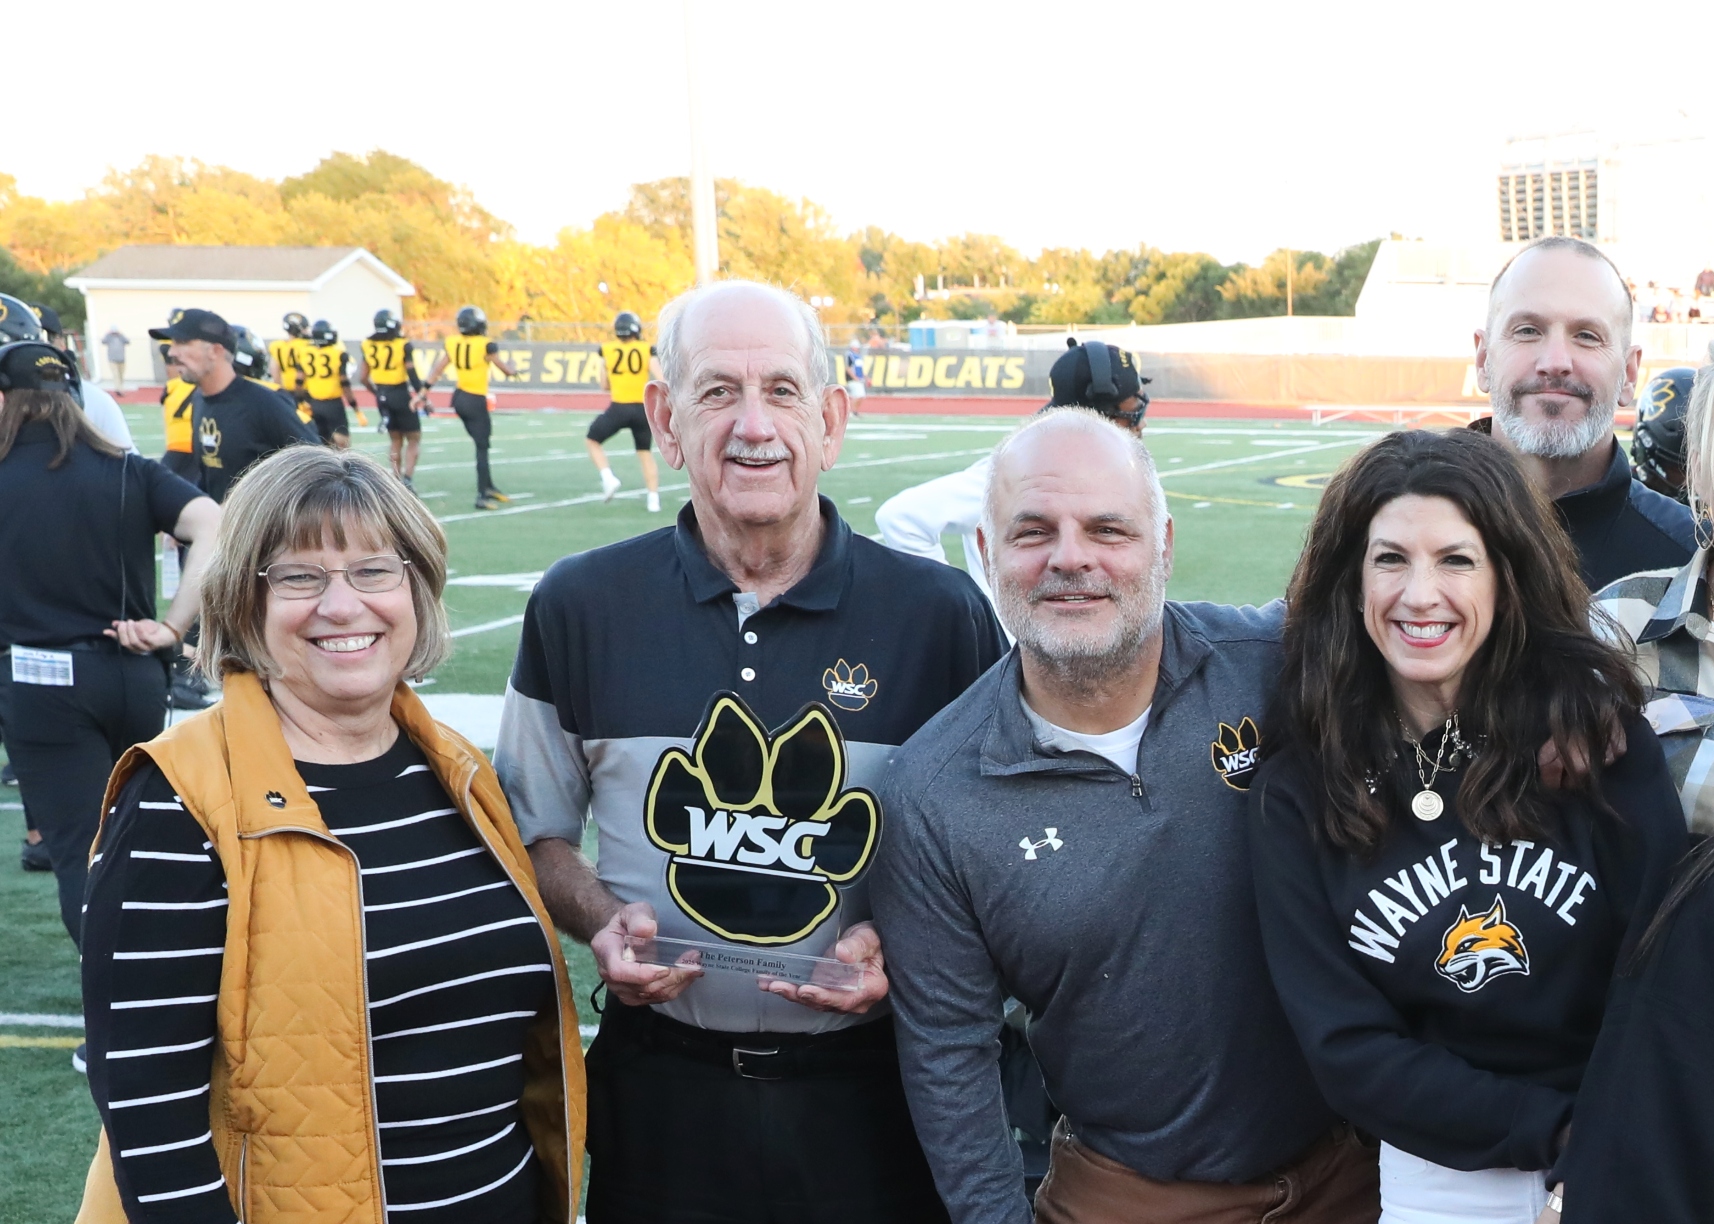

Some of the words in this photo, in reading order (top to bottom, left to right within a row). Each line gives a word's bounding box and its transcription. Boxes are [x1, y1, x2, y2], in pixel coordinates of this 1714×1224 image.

[306, 352, 333, 379] 33
[369, 344, 397, 371] 32
[455, 342, 472, 370] 11
[611, 347, 644, 375] 20
[830, 680, 867, 696] WSC
[684, 805, 831, 872] WSC
[1348, 837, 1468, 964] WAYNE
[1479, 835, 1597, 927] STATE
[699, 950, 716, 961] The
[717, 953, 754, 966] Peterson
[757, 958, 787, 970] Family
